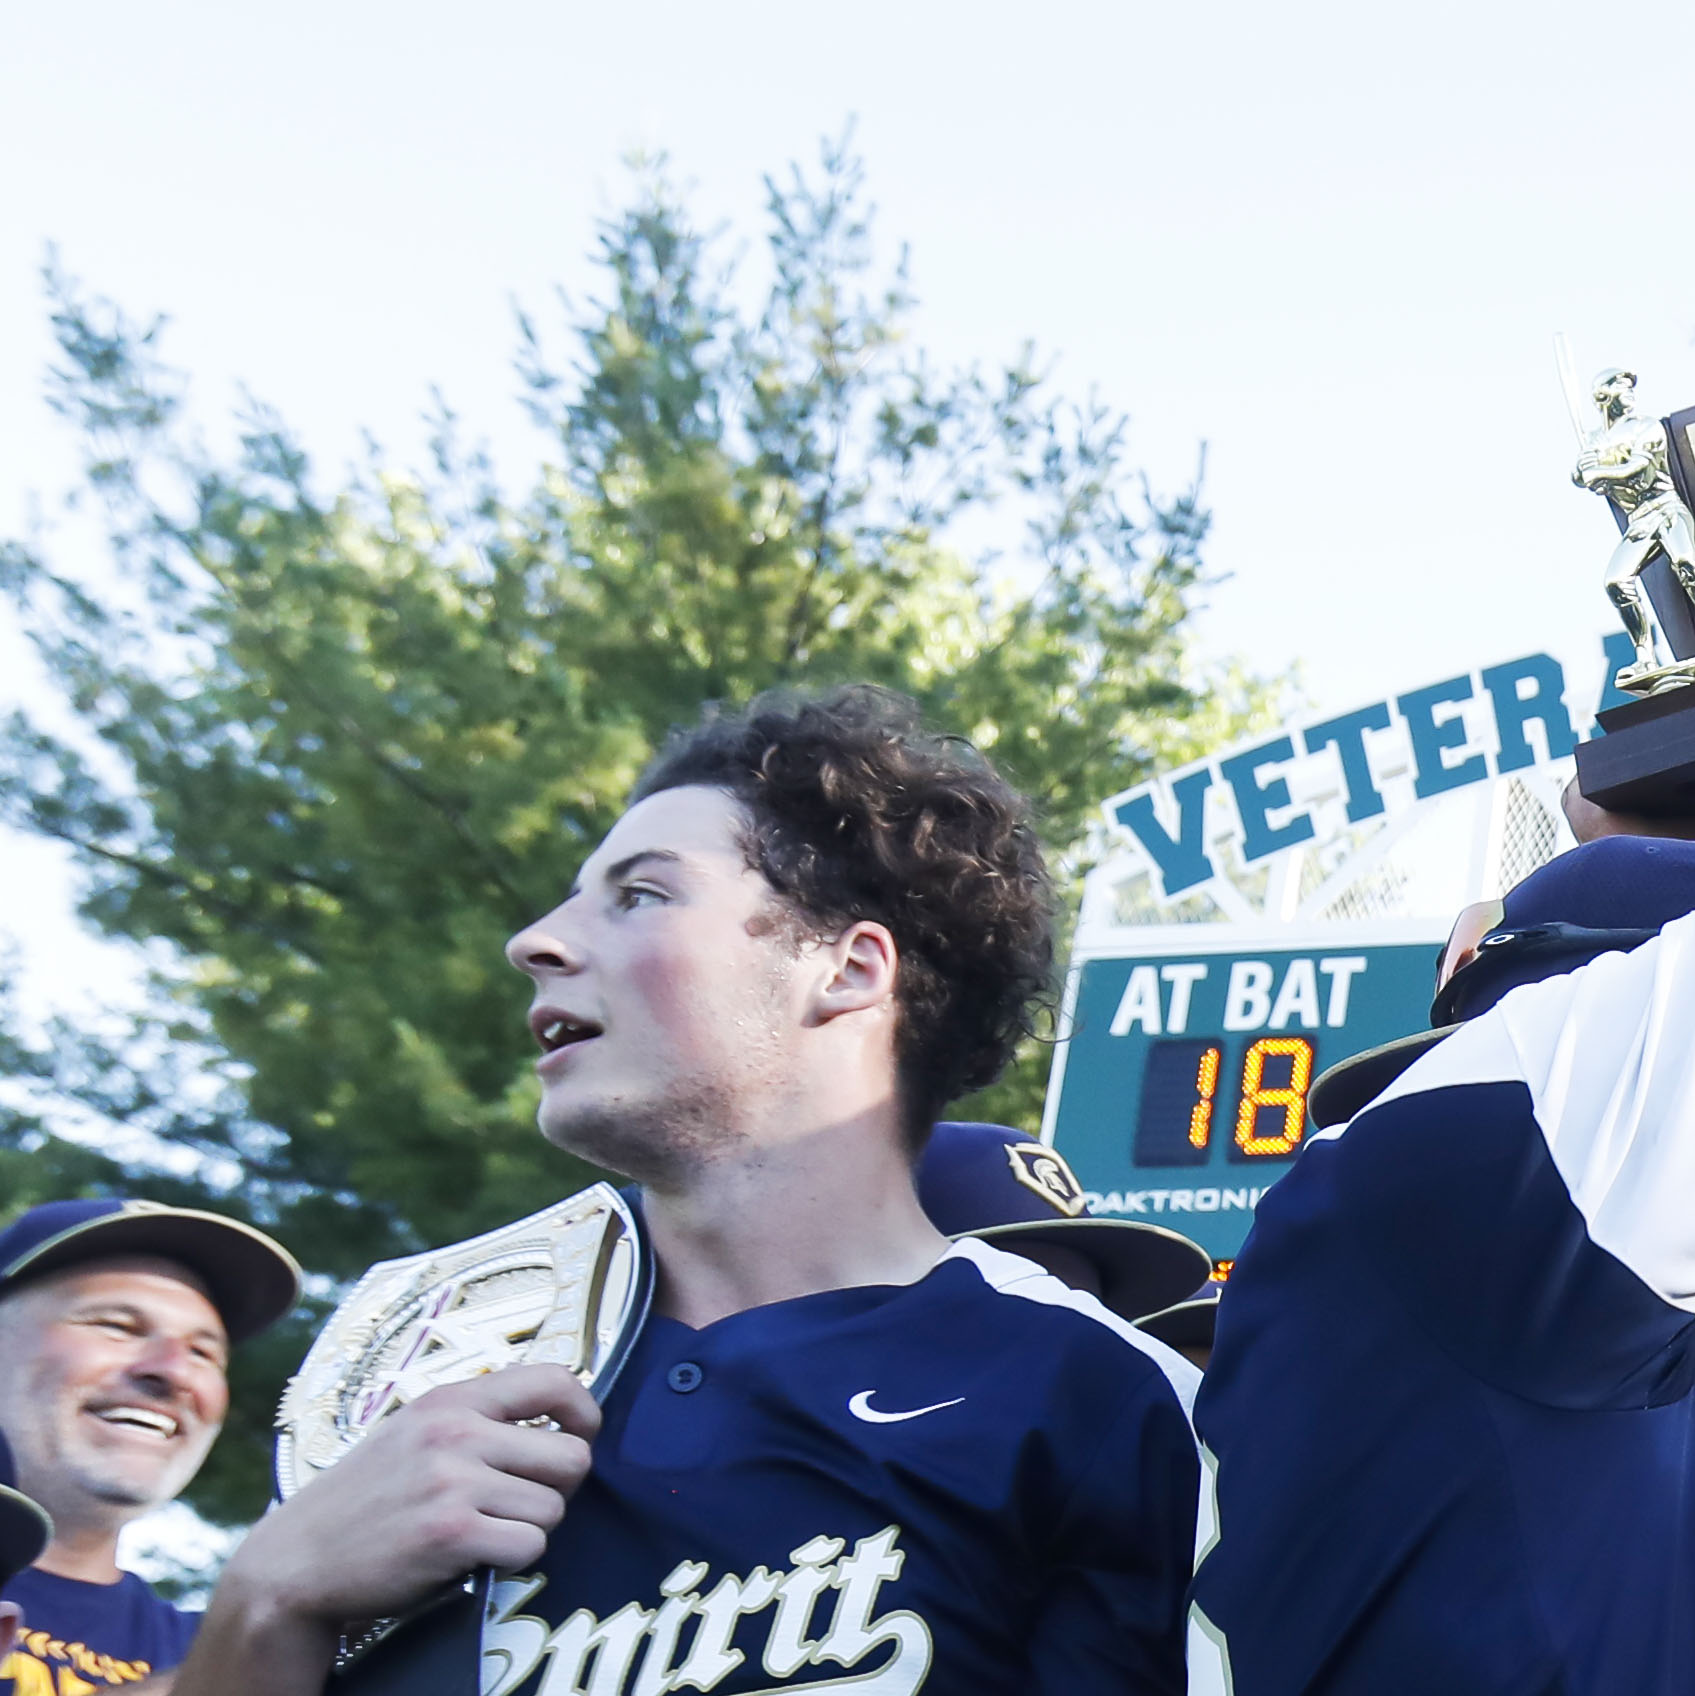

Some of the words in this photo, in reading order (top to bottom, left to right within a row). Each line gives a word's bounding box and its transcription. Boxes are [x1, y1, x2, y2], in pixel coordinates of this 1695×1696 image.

[1114, 625, 1658, 897] VETER
[1109, 964, 1207, 1036] AT
[1223, 957, 1367, 1033] BAT
[1189, 1037, 1313, 1156] 18
[1082, 1187, 1271, 1215] DAKTRONI
